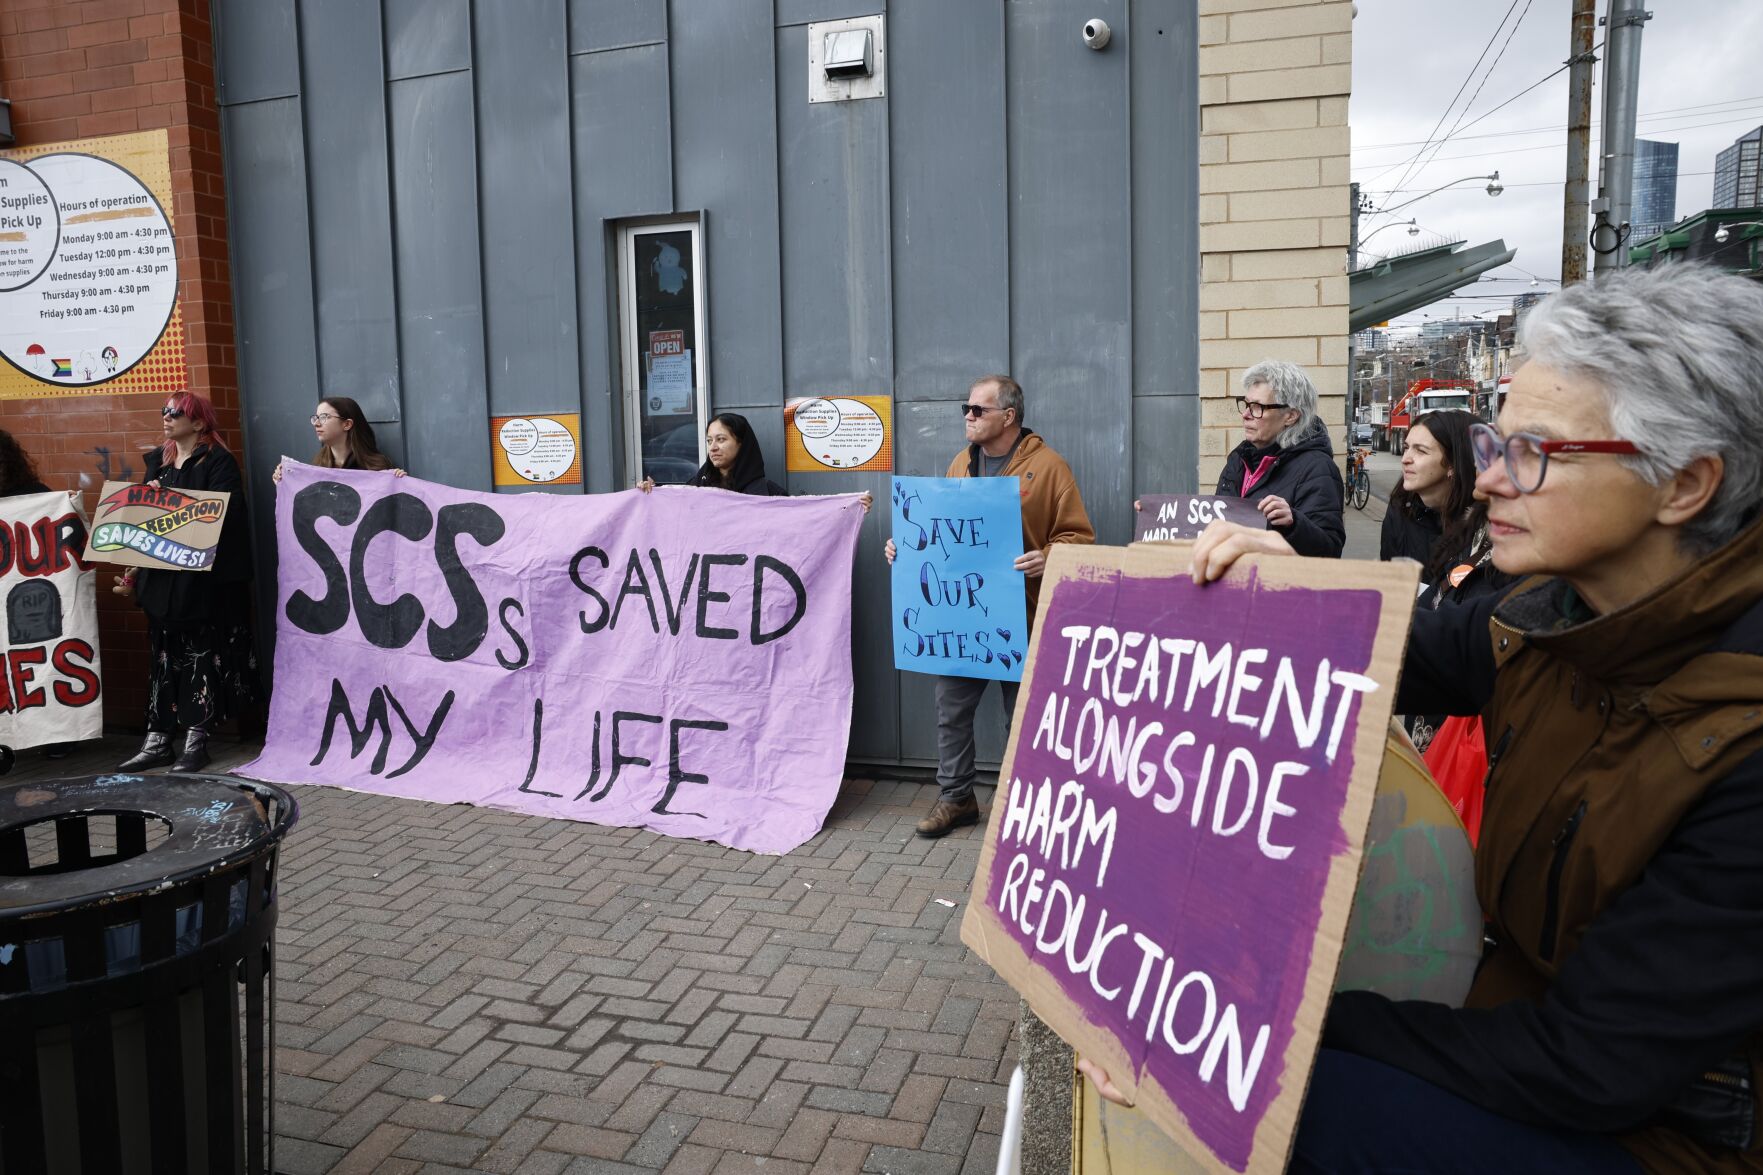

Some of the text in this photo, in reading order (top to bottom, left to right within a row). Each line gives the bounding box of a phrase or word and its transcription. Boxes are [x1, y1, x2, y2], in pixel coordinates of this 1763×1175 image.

[1, 194, 48, 210] Supplies
[60, 194, 148, 212] Hours of operation
[1, 215, 42, 229] Pick Up
[62, 233, 95, 244] Monday
[97, 231, 113, 241] 9:00
[116, 231, 128, 240] am
[135, 228, 152, 237] 4:30
[154, 228, 168, 239] pm
[59, 251, 93, 262] Tuesday
[95, 249, 116, 259] 12:00
[118, 248, 131, 259] pm
[138, 246, 154, 255] 4:30
[156, 246, 170, 256] pm
[6, 269, 30, 278] supplies
[49, 269, 96, 282] Wednesday
[98, 268, 114, 277] 9:00
[116, 268, 129, 276] am
[136, 264, 153, 274] 4:30
[155, 264, 168, 275] pm
[42, 290, 80, 301] Thursday
[81, 288, 97, 297] 9:00
[118, 284, 135, 294] 4:30
[137, 284, 150, 295] pm
[40, 308, 64, 319] Friday
[66, 307, 83, 317] 9:00
[84, 307, 97, 315] am
[103, 304, 119, 314] 4:30
[121, 304, 134, 315] pm
[654, 340, 680, 354] OPEN
[128, 489, 183, 508] HARM
[146, 501, 221, 533] REDUCTION
[1156, 500, 1178, 524] AN
[902, 490, 989, 562] SAVE
[97, 526, 206, 567] SAVES LIVES!
[22, 592, 48, 608] RIP
[569, 546, 807, 646] SAVED
[920, 561, 989, 617] OUR
[902, 607, 994, 664] SITES
[1061, 625, 1380, 767] TREATMENT
[310, 678, 455, 779] MY
[518, 698, 729, 819] LIFE
[1032, 692, 1310, 860] ALONGSIDE
[1002, 776, 1117, 888] HARM
[1000, 853, 1271, 1112] REDUCTION
